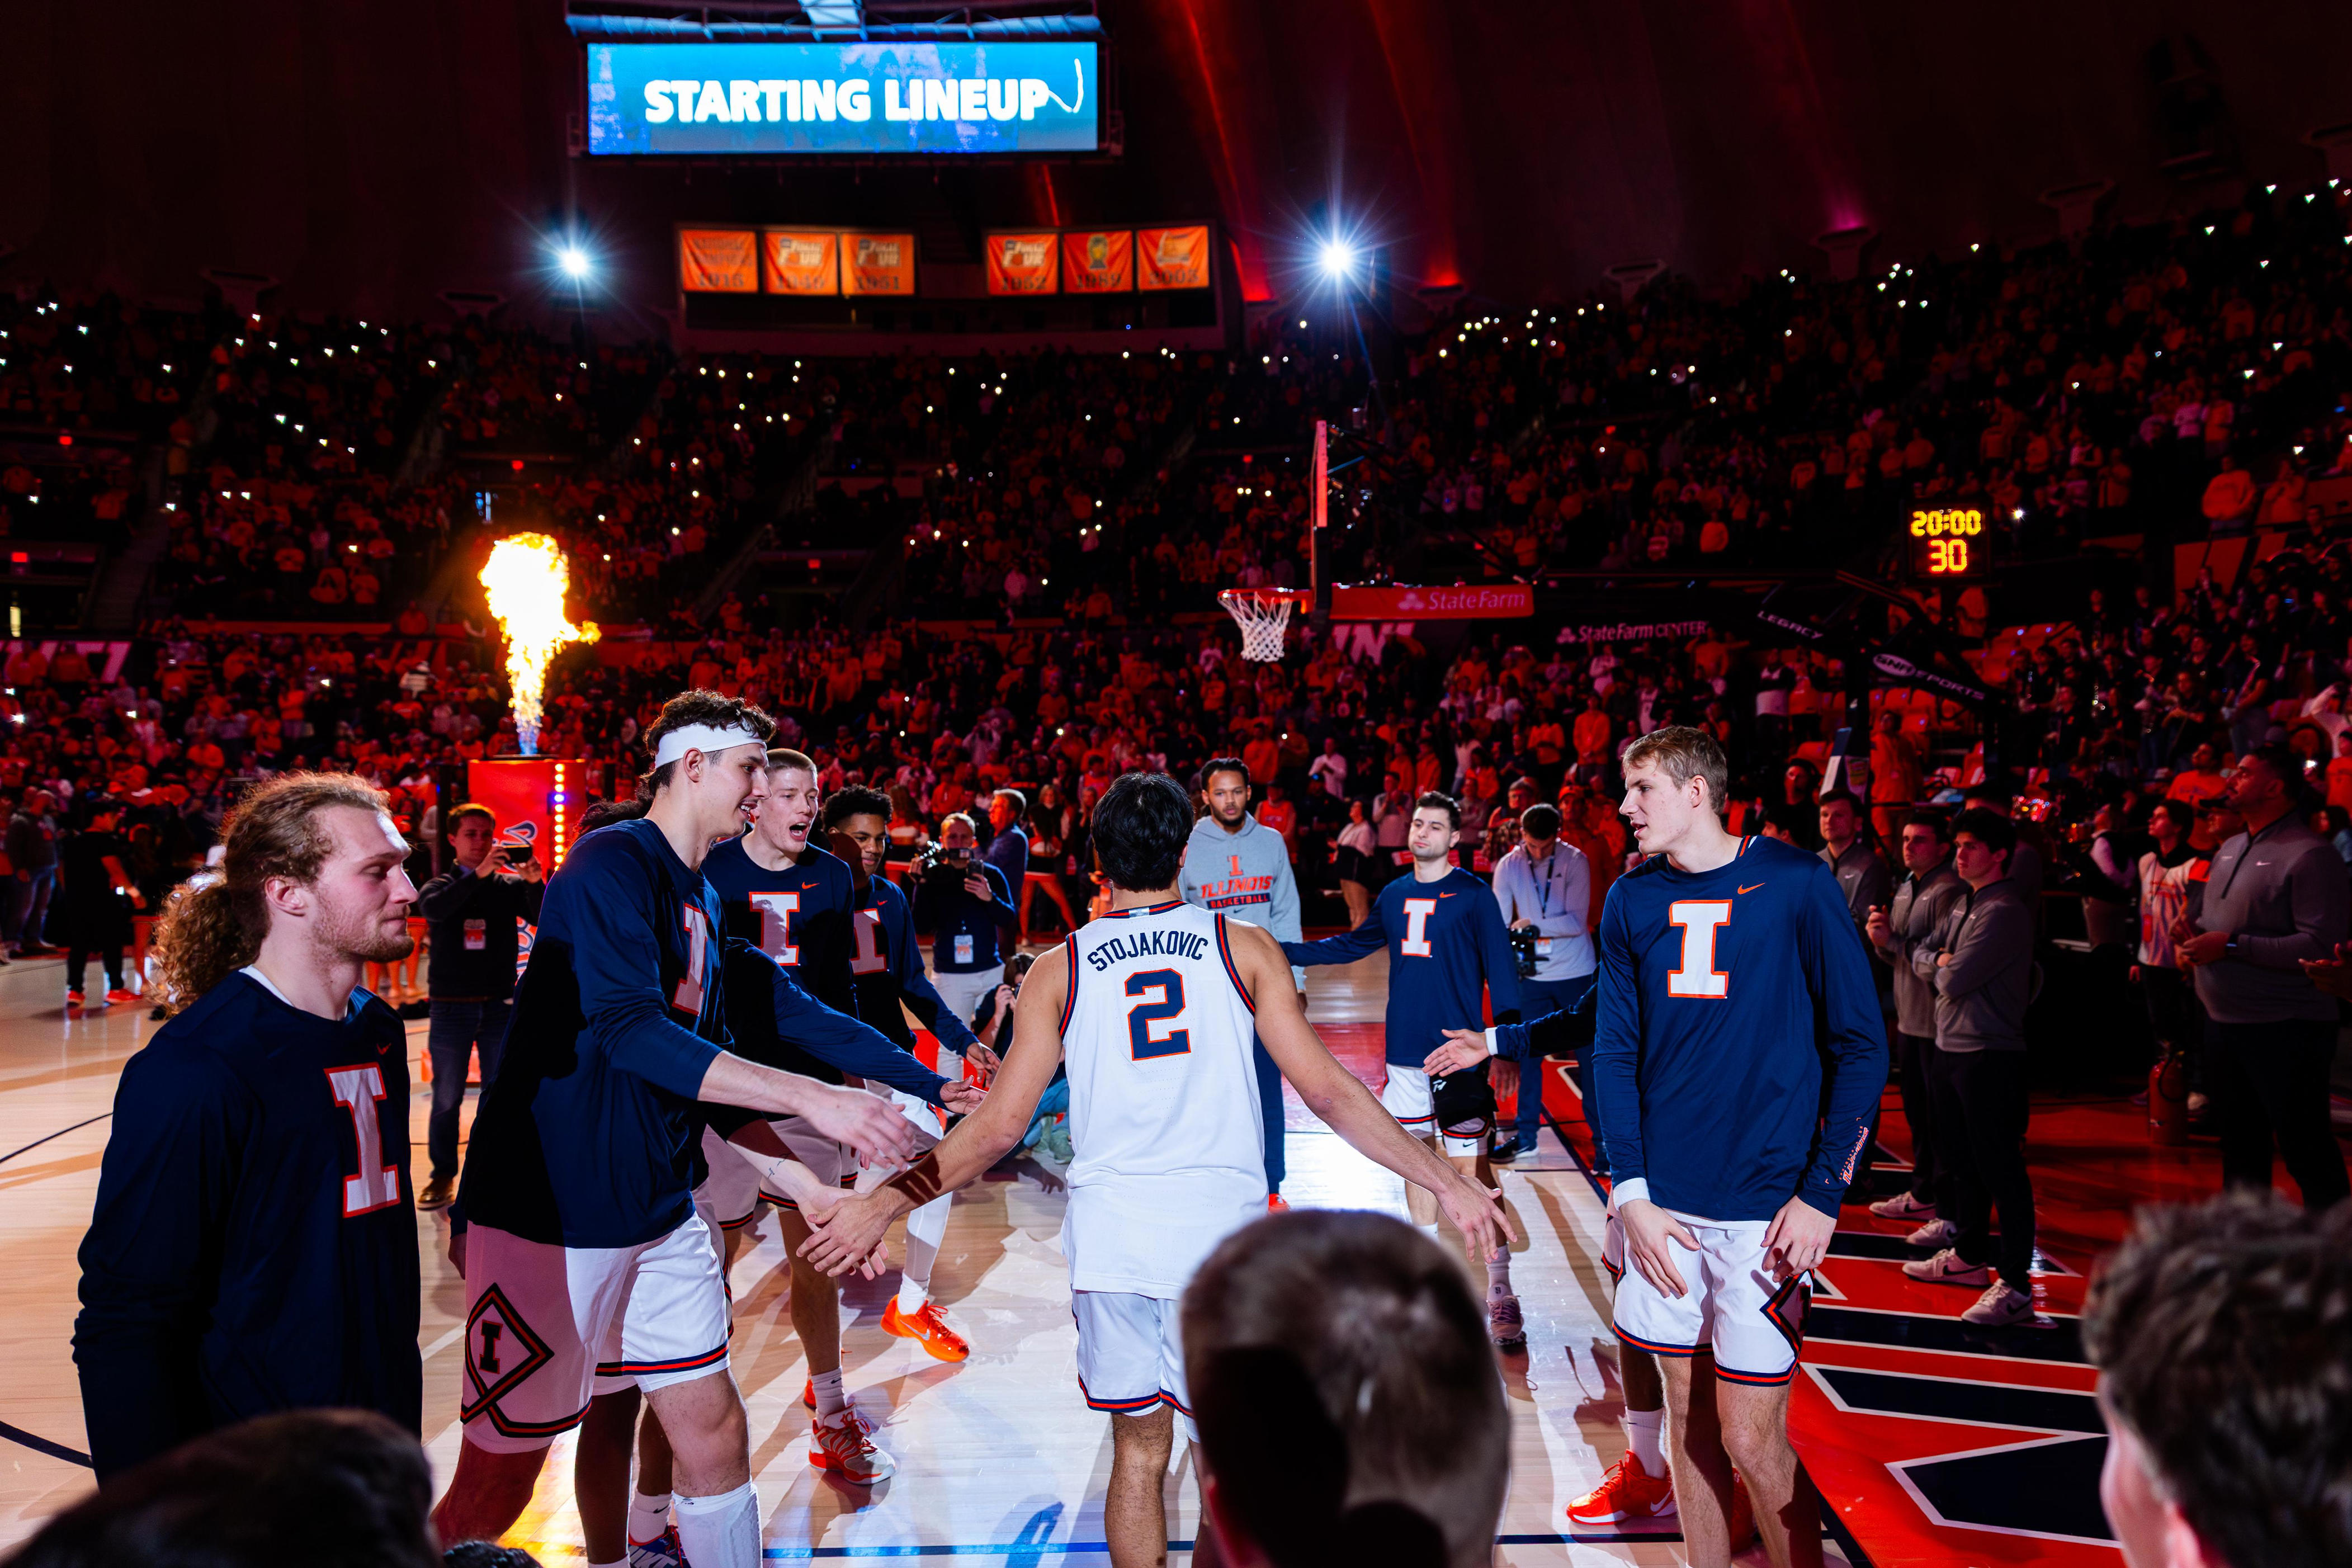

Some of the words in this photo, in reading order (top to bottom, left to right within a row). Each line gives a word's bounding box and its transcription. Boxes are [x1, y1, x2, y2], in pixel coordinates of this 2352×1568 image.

[644, 79, 871, 123] STARTING
[884, 78, 1050, 121] LINEUP
[1911, 510, 1981, 537] 20:00
[1929, 539, 1967, 573] 30
[1756, 610, 1824, 639] LEGACY
[1201, 876, 1273, 899] ILLINOIS
[1210, 894, 1268, 909] BASKETBALL
[748, 891, 800, 966] I
[1087, 930, 1208, 972] STOJAKOVIC
[1401, 898, 1437, 957] I
[1668, 899, 1733, 999] I
[672, 902, 710, 1017] I
[1125, 968, 1191, 1061] 2
[323, 1061, 401, 1218] I
[479, 1319, 503, 1375] I
